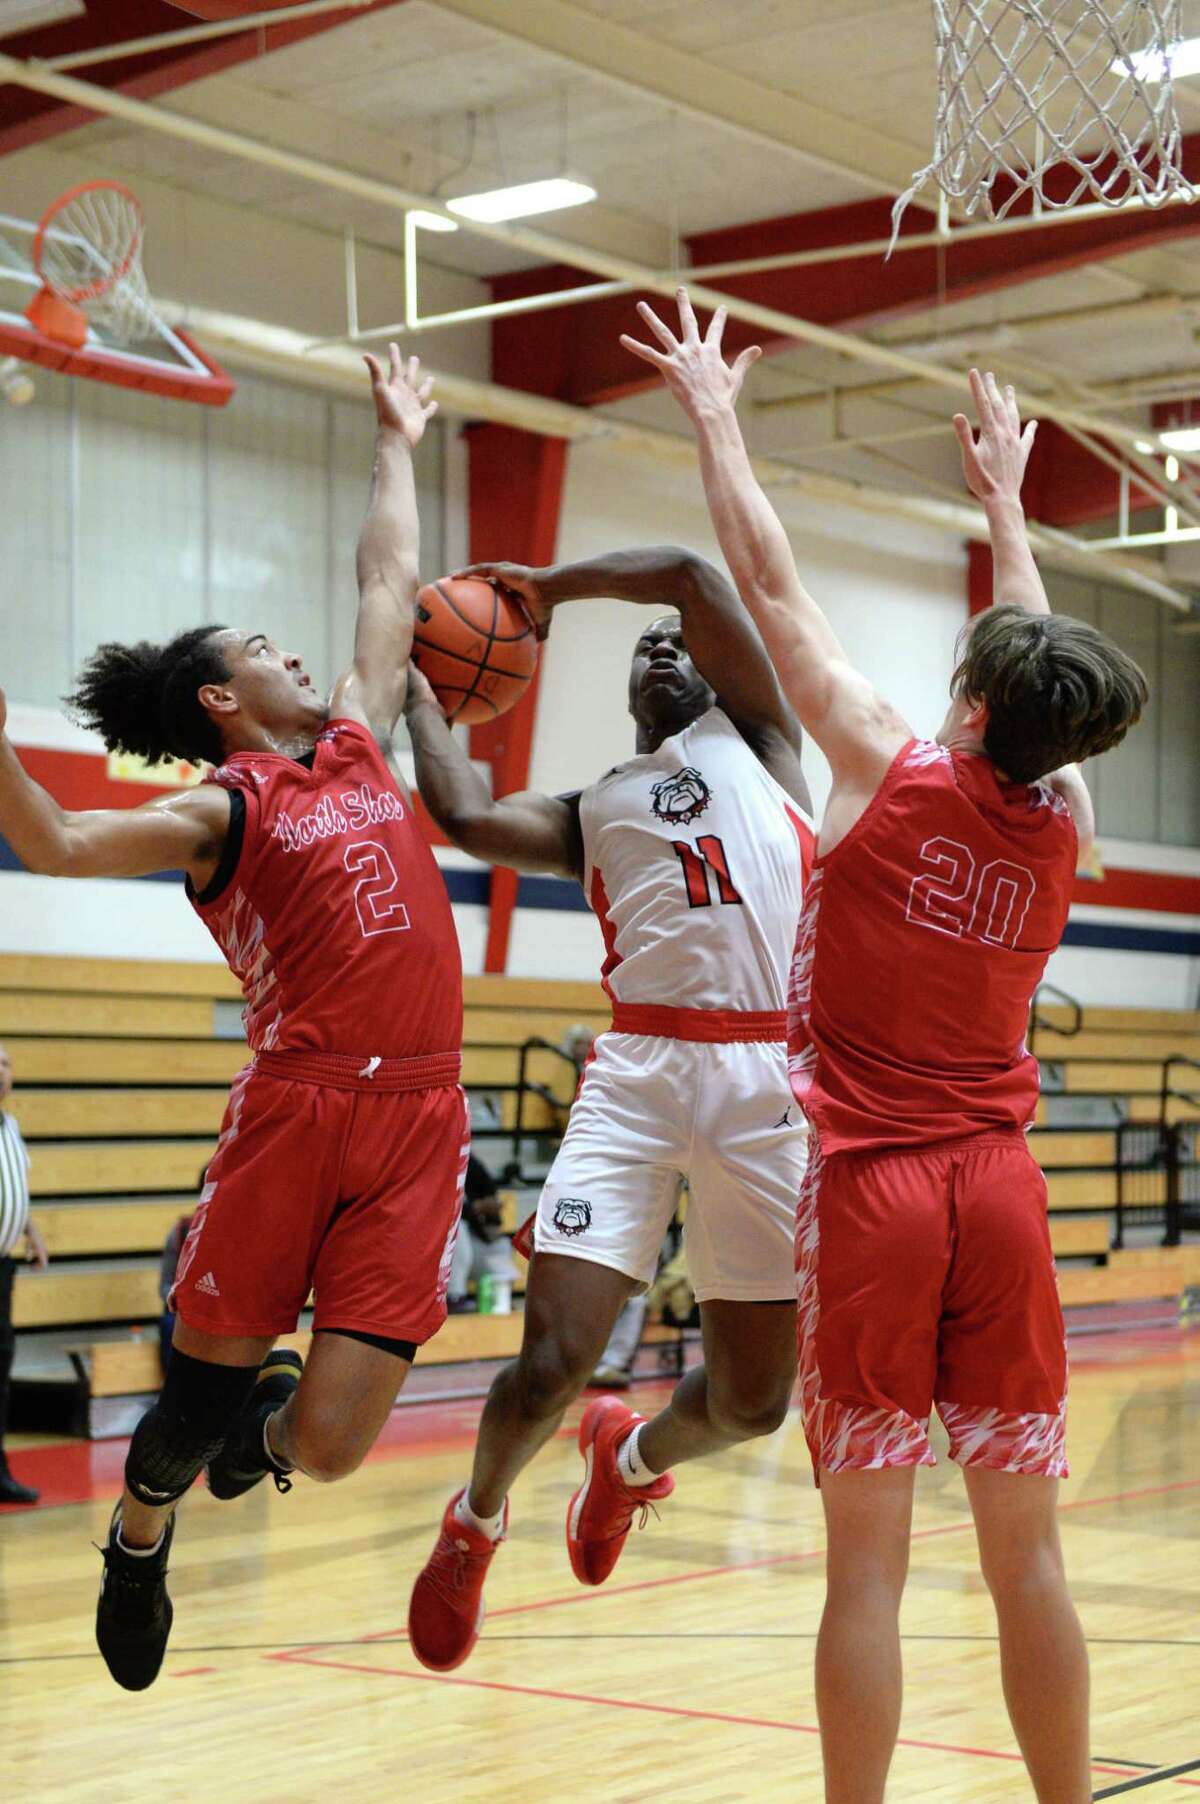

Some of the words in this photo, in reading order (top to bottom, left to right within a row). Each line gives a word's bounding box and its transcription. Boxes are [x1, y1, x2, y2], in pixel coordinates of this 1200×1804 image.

[271, 795, 348, 852] North
[343, 841, 411, 938] 2
[670, 834, 743, 909] 11
[905, 835, 1036, 951] 20
